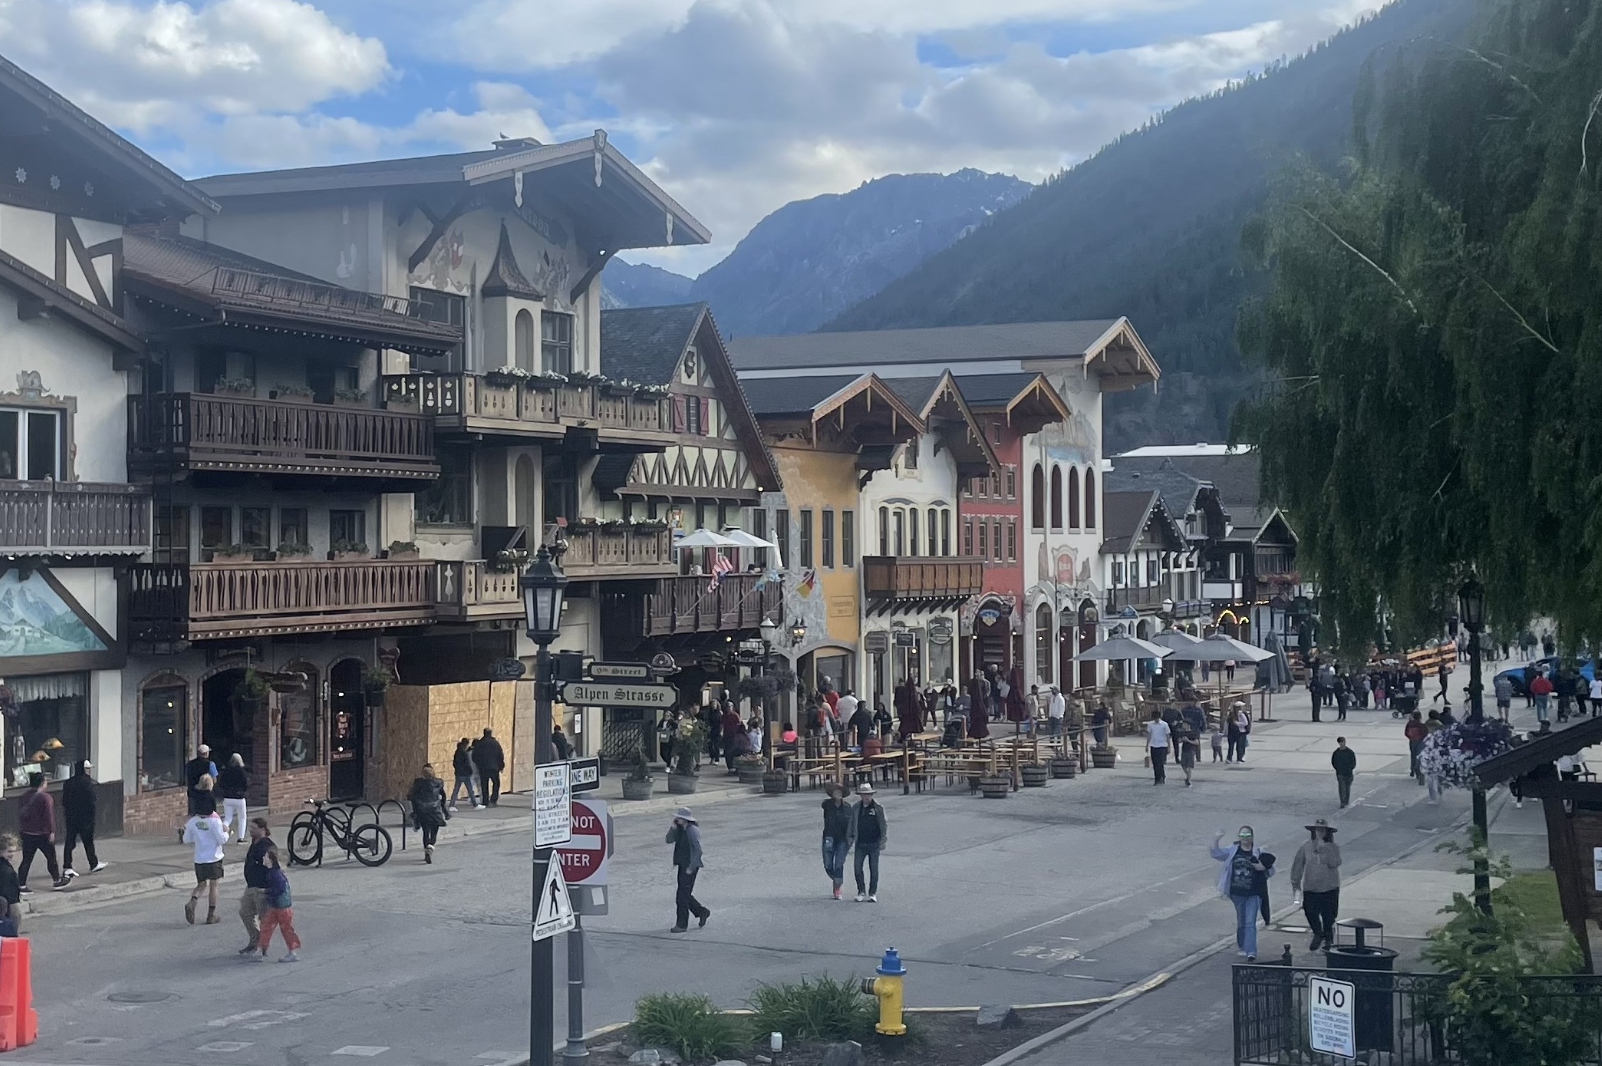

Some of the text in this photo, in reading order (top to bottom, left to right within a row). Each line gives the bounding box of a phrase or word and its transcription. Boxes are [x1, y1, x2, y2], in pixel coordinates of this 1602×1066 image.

[611, 667, 642, 675] Street
[574, 686, 665, 702] Alpen Strasse
[583, 767, 596, 781] WAY
[542, 778, 563, 787] PARKING
[536, 786, 569, 798] REGULATIONS
[571, 816, 595, 829] NOT
[558, 853, 590, 867] NTER
[1318, 986, 1345, 1008] NO
